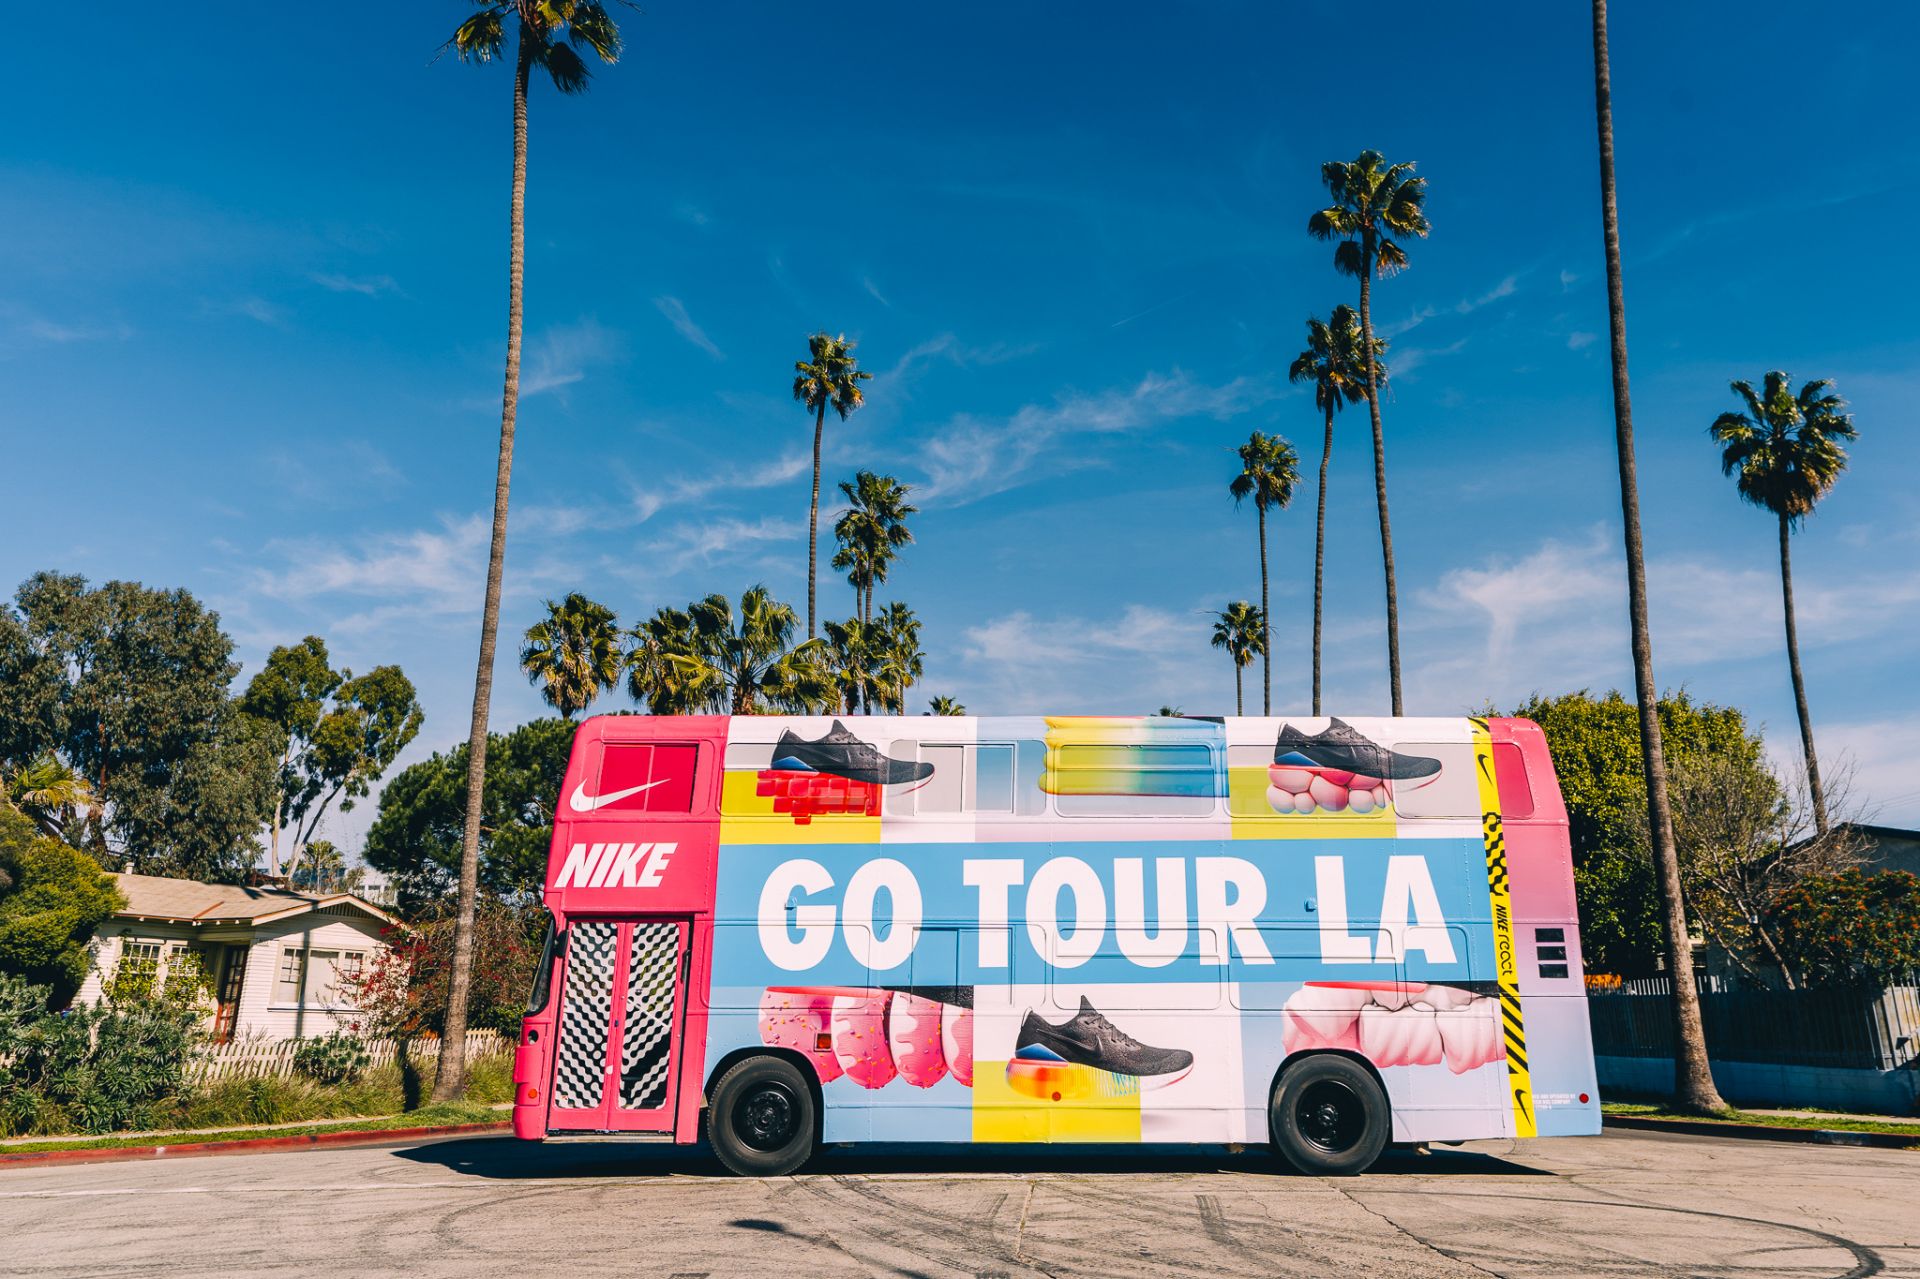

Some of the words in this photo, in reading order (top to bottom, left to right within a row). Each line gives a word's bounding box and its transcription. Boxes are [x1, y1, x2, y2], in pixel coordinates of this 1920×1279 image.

[554, 842, 678, 888] NIKE
[757, 859, 922, 970] GO
[963, 857, 1275, 969] TOUR
[1315, 856, 1458, 964] LA
[1495, 903, 1509, 933] NIKE
